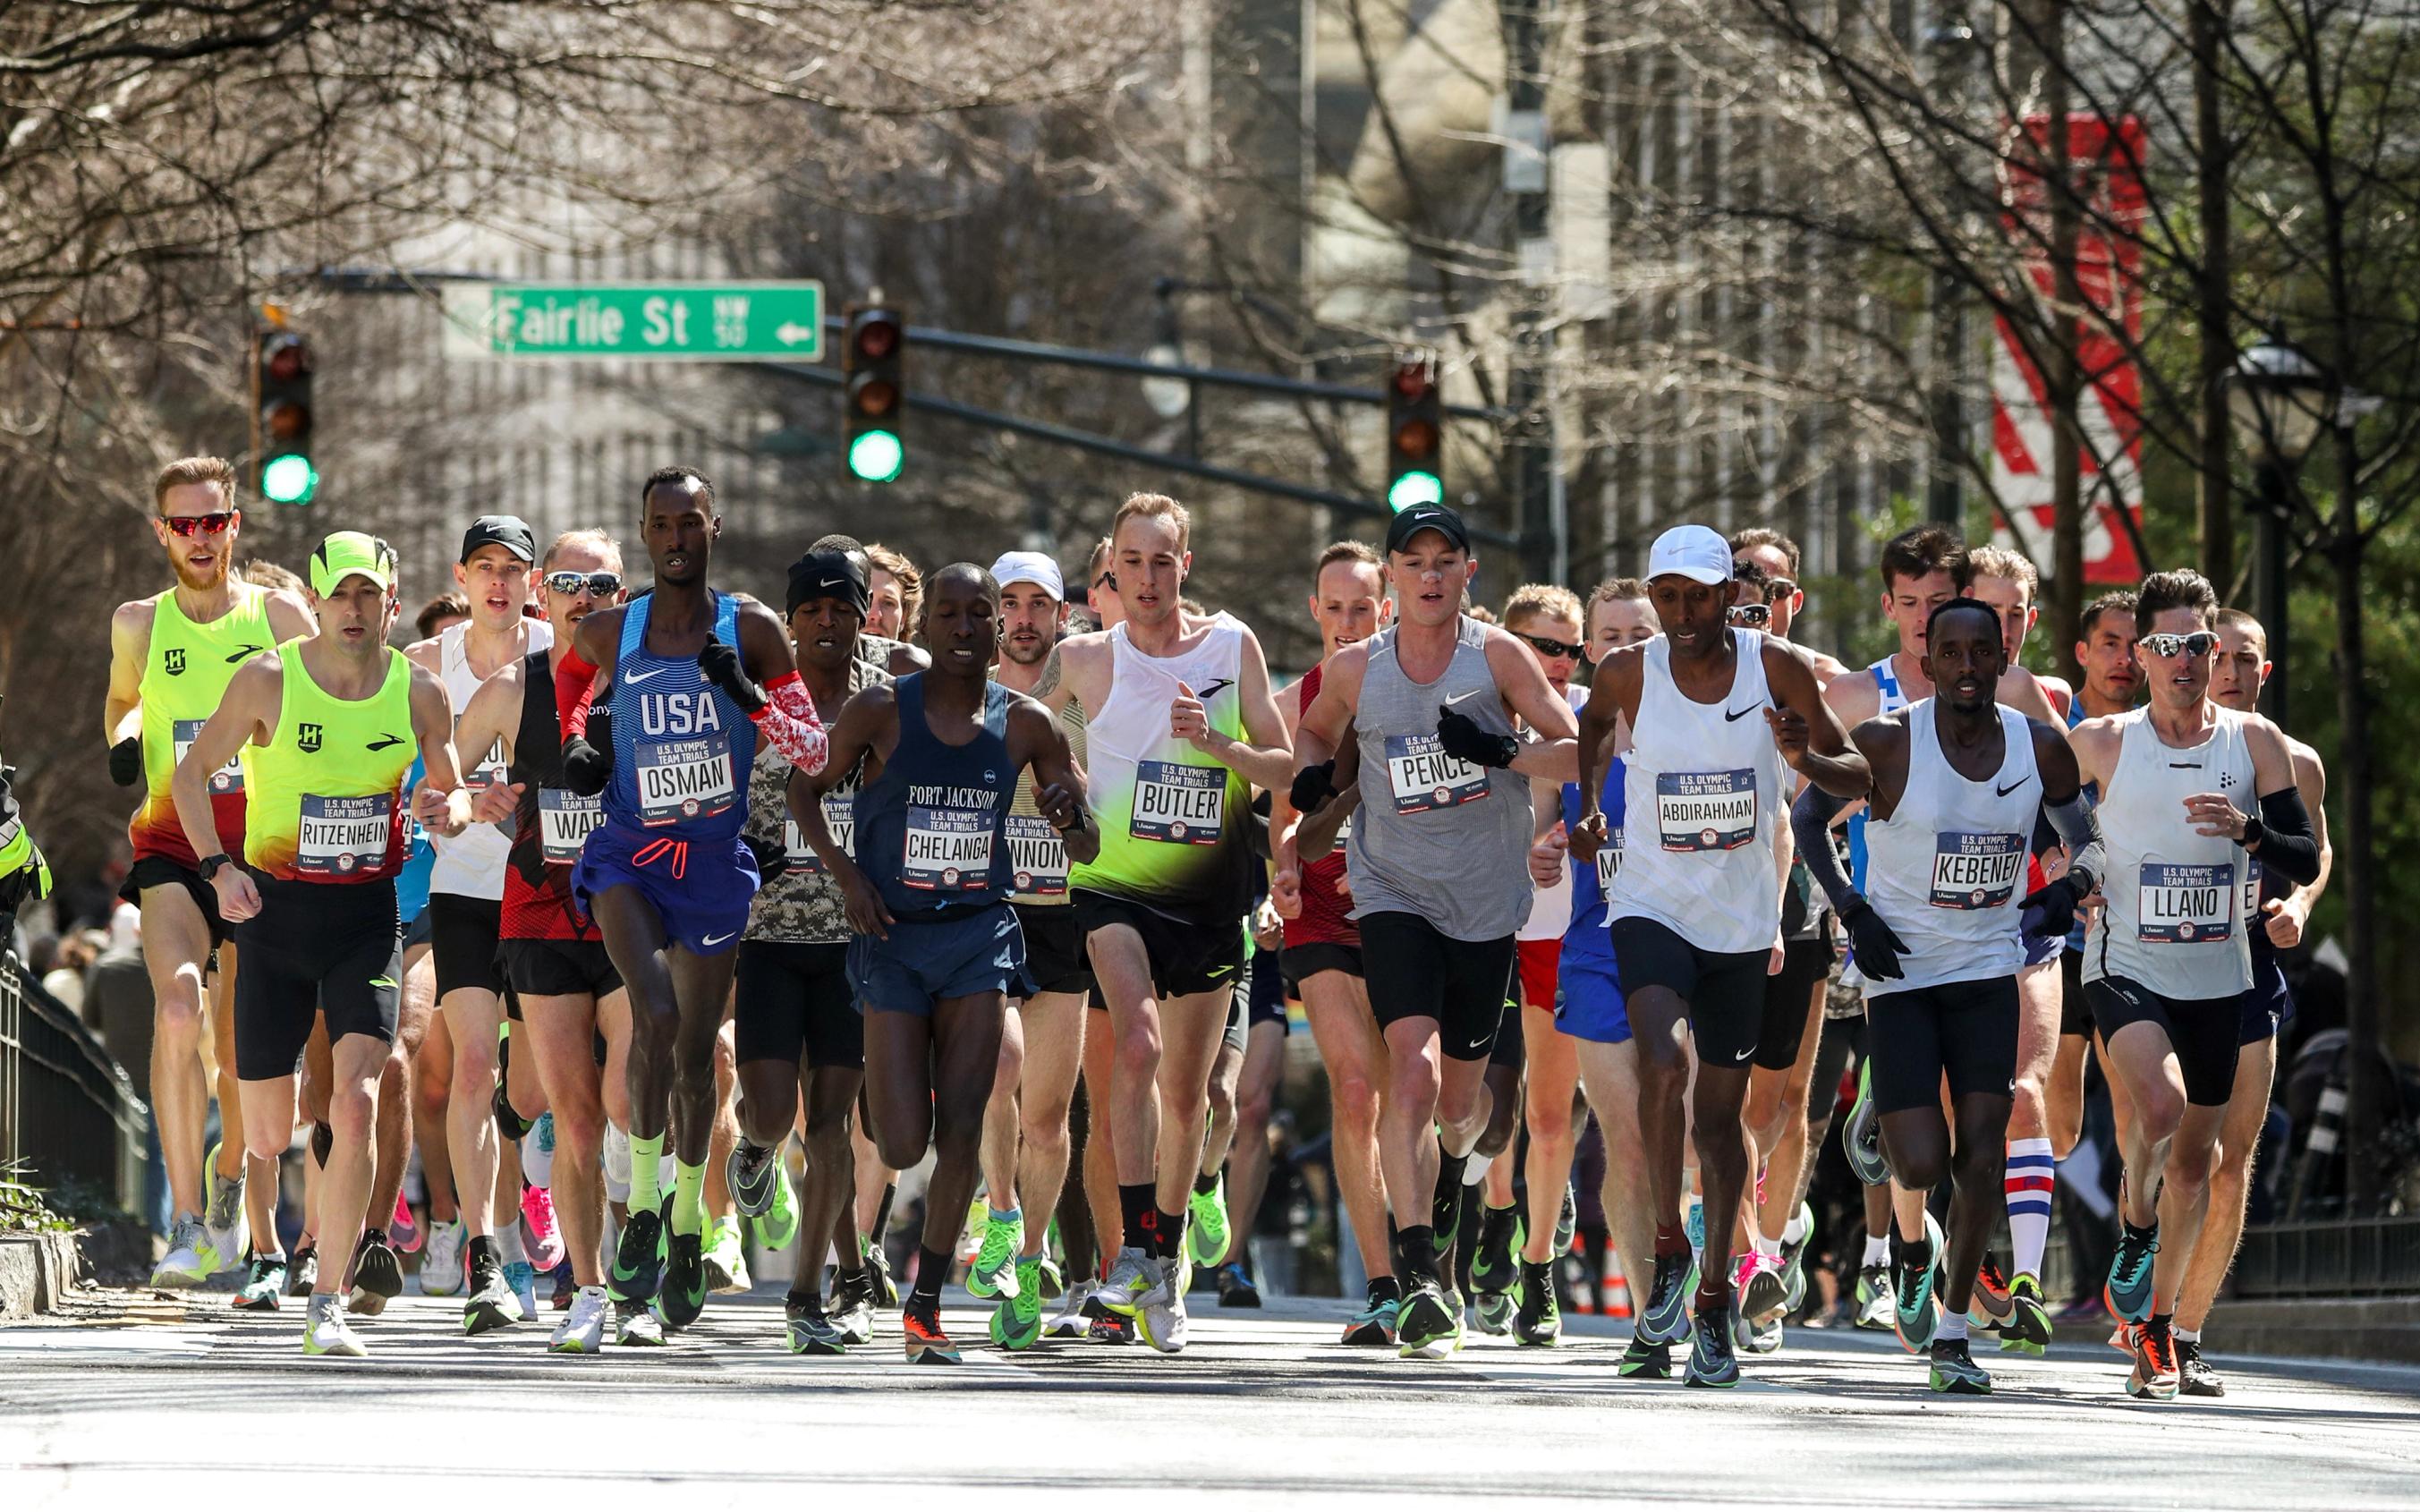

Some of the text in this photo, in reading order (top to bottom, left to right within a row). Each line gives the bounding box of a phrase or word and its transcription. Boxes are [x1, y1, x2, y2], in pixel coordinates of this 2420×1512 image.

[714, 296, 751, 319] NW
[496, 295, 689, 346] Fairlie St
[641, 692, 720, 735] USA
[1405, 736, 1421, 745] U.S.
[657, 740, 709, 755] U.S. OLYMPIC
[1407, 744, 1429, 755] TEAM
[658, 750, 709, 765] TEAM TRIALS
[1162, 764, 1210, 778] U.S. OLYMPIC
[1403, 752, 1471, 787] PENCE
[647, 758, 724, 799] OSMAN
[1161, 774, 1209, 787] TEAM TRIALS
[1680, 773, 1731, 785] U.S. OLYMPIC
[1680, 784, 1732, 794] TEAM TRIALS
[561, 791, 576, 800] U.S.
[909, 786, 998, 810] FORT JACKSON
[325, 798, 373, 809] U.S. OLYMPIC
[561, 799, 601, 810] TEAM TRIA
[826, 803, 852, 811] OLYMPI
[1142, 784, 1218, 820] BUTLER
[325, 807, 373, 819] TEAM TRIALS
[831, 811, 853, 820] TRIAL
[1662, 798, 1752, 821] ABDIRAHMAN
[930, 811, 945, 821] U.S.
[947, 812, 978, 822] OLYMPIC
[930, 821, 978, 832] TEAM TRIALS
[1018, 819, 1050, 828] OLYMPIC
[302, 821, 388, 845] RITZENHEIN
[1006, 827, 1050, 837] EAM TRIALS
[1962, 835, 2008, 845] U.S. OLYMPIC
[908, 834, 989, 861] CHELANGA
[1961, 844, 2007, 854] TEAM TRIALS
[1010, 839, 1064, 869] NNON
[1938, 854, 2018, 884] KEBENEI
[2163, 867, 2212, 877] U.S. OLYMPIC
[2163, 877, 2212, 887] TEAM TRIALS
[2154, 888, 2218, 917] LLANO
